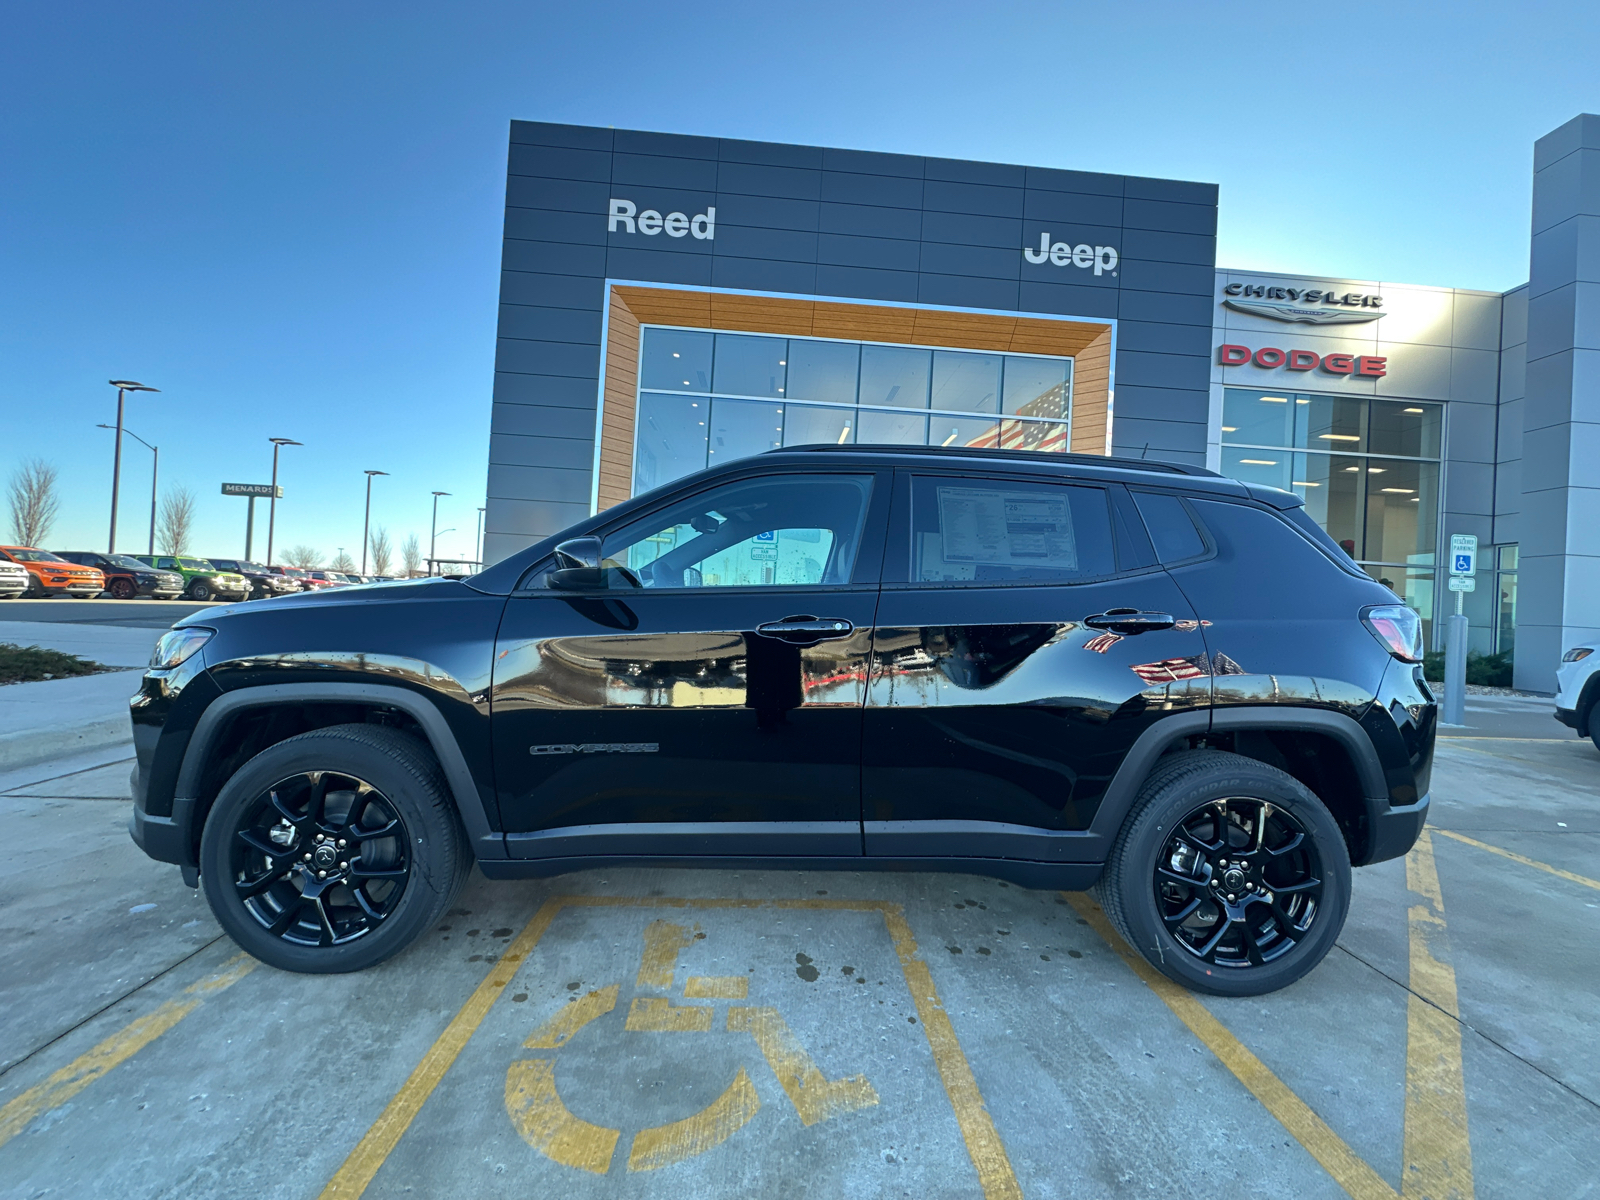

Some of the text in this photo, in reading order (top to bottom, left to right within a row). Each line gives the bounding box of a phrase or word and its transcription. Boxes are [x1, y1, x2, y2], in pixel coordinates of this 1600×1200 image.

[607, 199, 716, 241] Reed
[1024, 232, 1118, 277] Jeep
[1225, 283, 1383, 307] CHRYSLER
[1218, 344, 1388, 378] DODGE
[225, 484, 273, 494] MENARDS
[529, 742, 660, 756] COMPASS
[1161, 779, 1240, 825] GEOLANDAR
